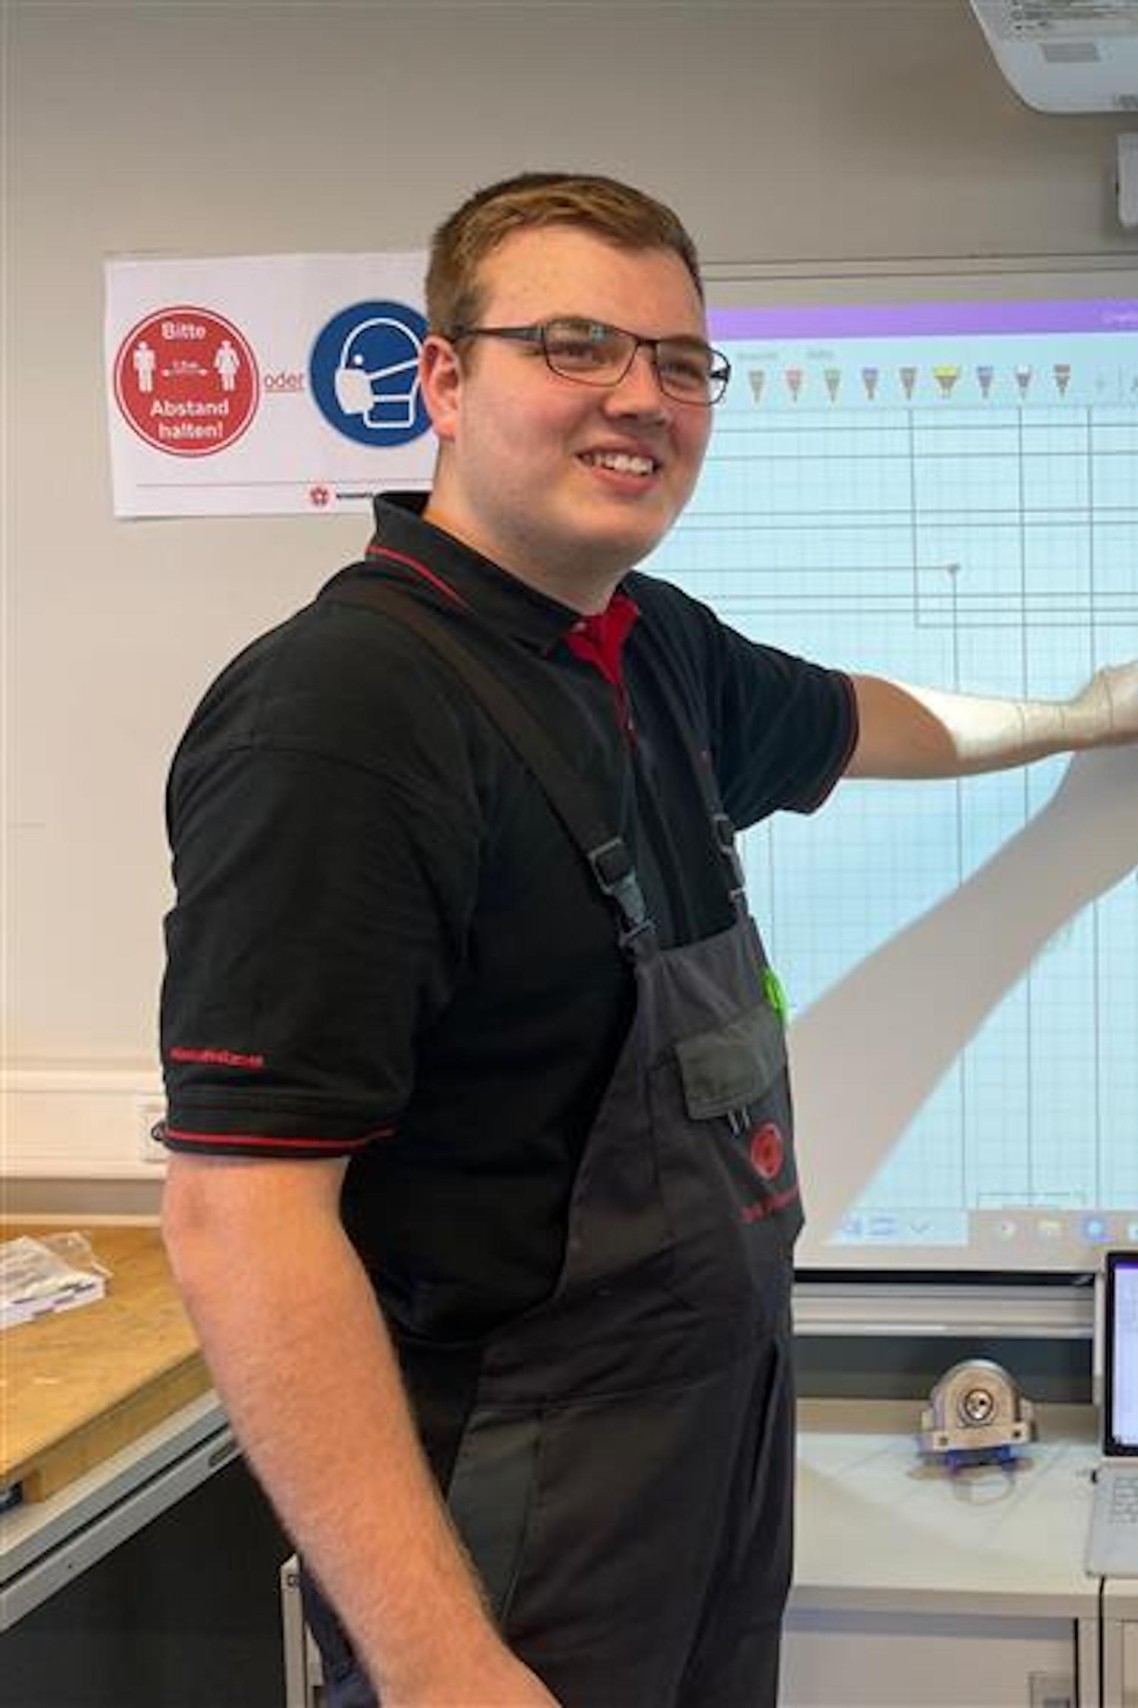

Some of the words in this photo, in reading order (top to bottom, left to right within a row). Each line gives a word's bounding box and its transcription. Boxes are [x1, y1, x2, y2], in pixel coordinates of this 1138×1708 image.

[161, 321, 207, 340] Bitte
[264, 371, 305, 391] oder
[150, 400, 229, 416] Abstand
[158, 422, 224, 440] halten!
